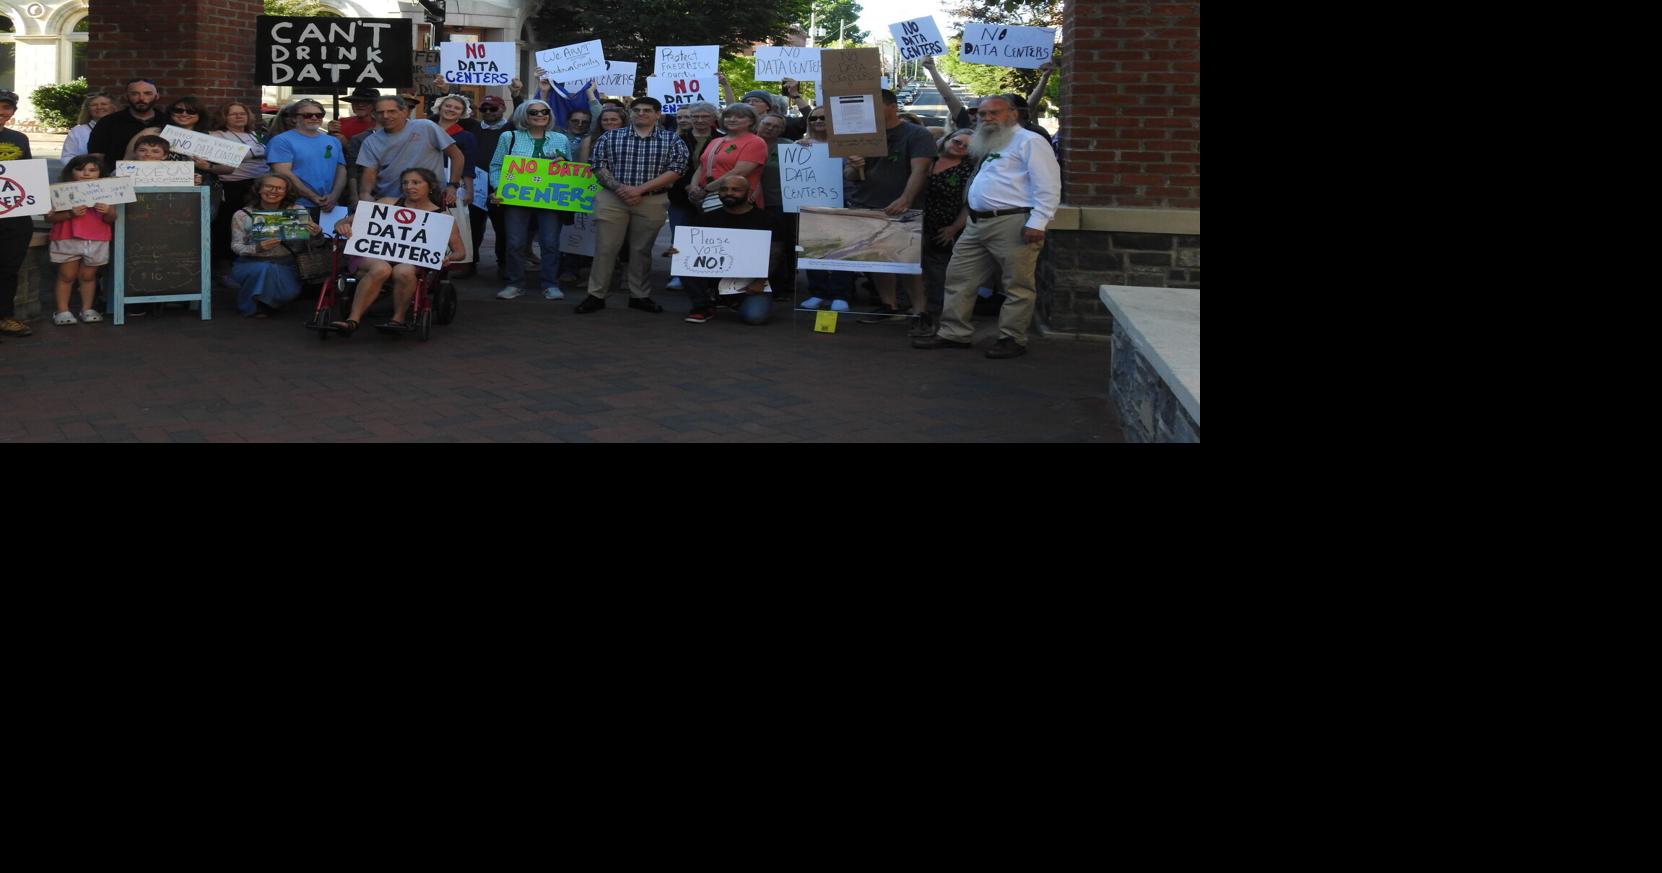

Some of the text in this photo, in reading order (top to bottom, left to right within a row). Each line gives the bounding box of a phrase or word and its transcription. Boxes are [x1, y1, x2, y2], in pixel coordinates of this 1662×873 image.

[271, 19, 391, 49] CAN'T
[904, 21, 919, 35] NO
[981, 27, 1008, 41] NO
[902, 34, 928, 46] DATA
[271, 44, 384, 64] DRINK
[465, 43, 486, 59] NO
[779, 47, 801, 57] NO
[901, 40, 943, 60] CENTERS
[964, 42, 1050, 60] DATA CENTERS
[271, 61, 384, 84] DATA
[458, 60, 499, 72] DATA
[757, 60, 788, 76] DATA
[445, 71, 509, 84] CENTERS
[673, 79, 700, 94] NO
[664, 93, 705, 104] DATA
[784, 147, 812, 166] NO
[508, 158, 593, 179] NO DATA
[785, 166, 817, 183] DATA
[501, 182, 593, 211] CENTERS
[783, 186, 839, 201] CENTERS
[367, 221, 427, 244] DATA
[690, 227, 730, 245] Please
[354, 238, 442, 265] CENTERS
[693, 245, 729, 256] VOTE
[693, 255, 725, 270] NO!
